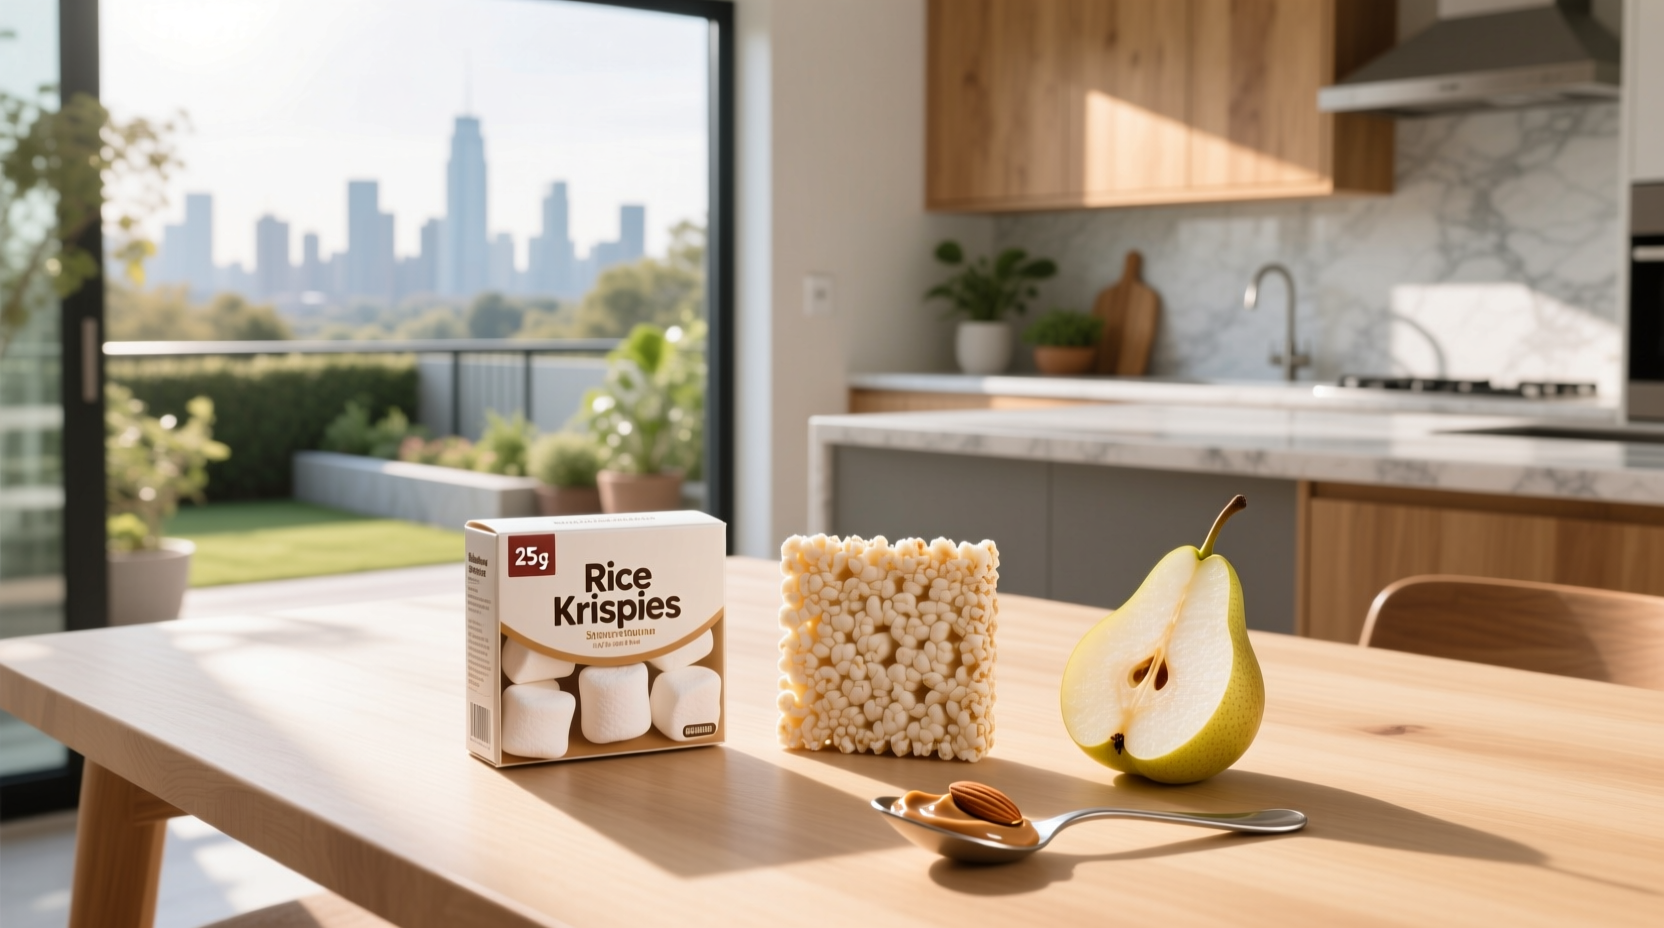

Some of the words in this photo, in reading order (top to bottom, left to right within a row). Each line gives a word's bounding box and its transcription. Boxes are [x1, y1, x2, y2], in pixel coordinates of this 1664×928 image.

[515, 546, 549, 571] 25g
[585, 560, 652, 593] Rice
[554, 589, 681, 629] Krispies
